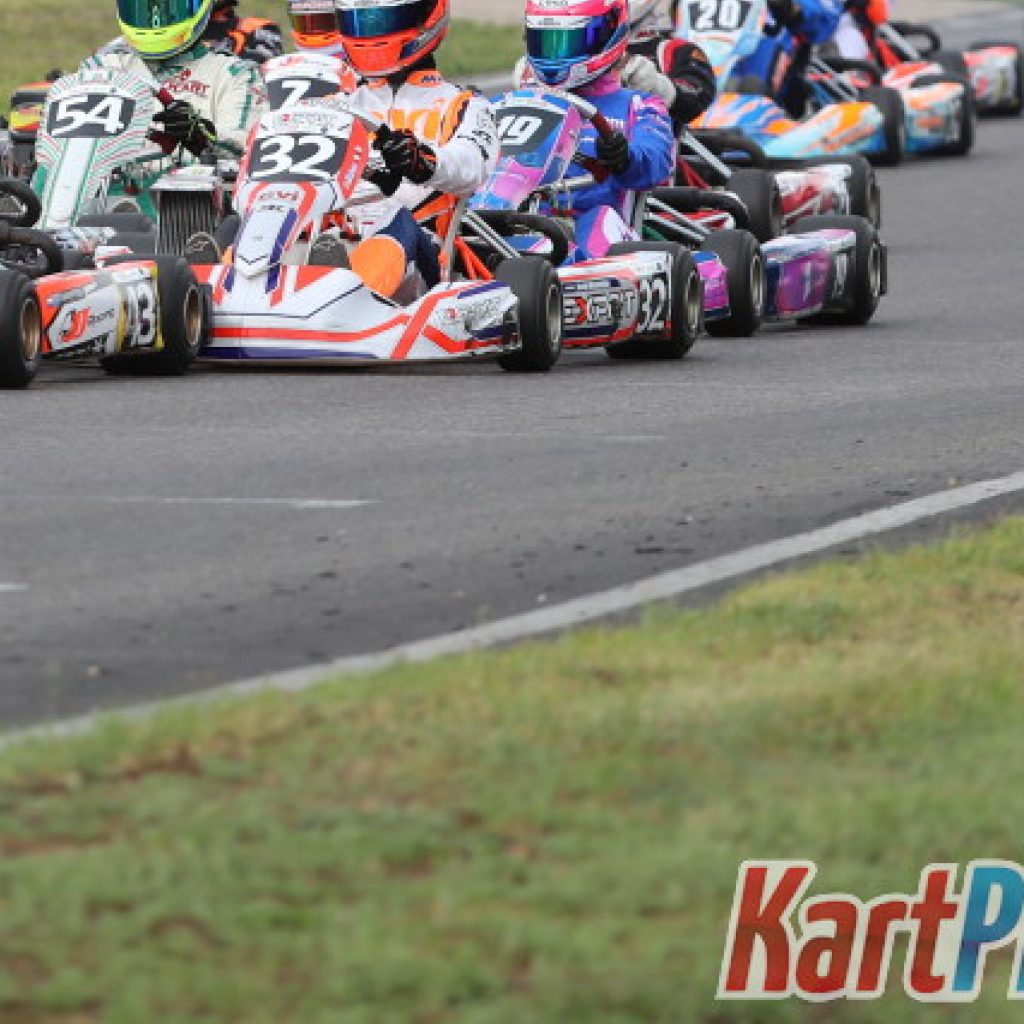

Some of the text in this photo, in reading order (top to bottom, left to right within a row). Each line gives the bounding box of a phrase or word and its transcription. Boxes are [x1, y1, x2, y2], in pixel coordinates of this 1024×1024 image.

[50, 95, 125, 136] 54
[280, 79, 312, 111] 7
[497, 114, 543, 146] 19
[251, 135, 337, 177] 32
[636, 278, 667, 334] 32
